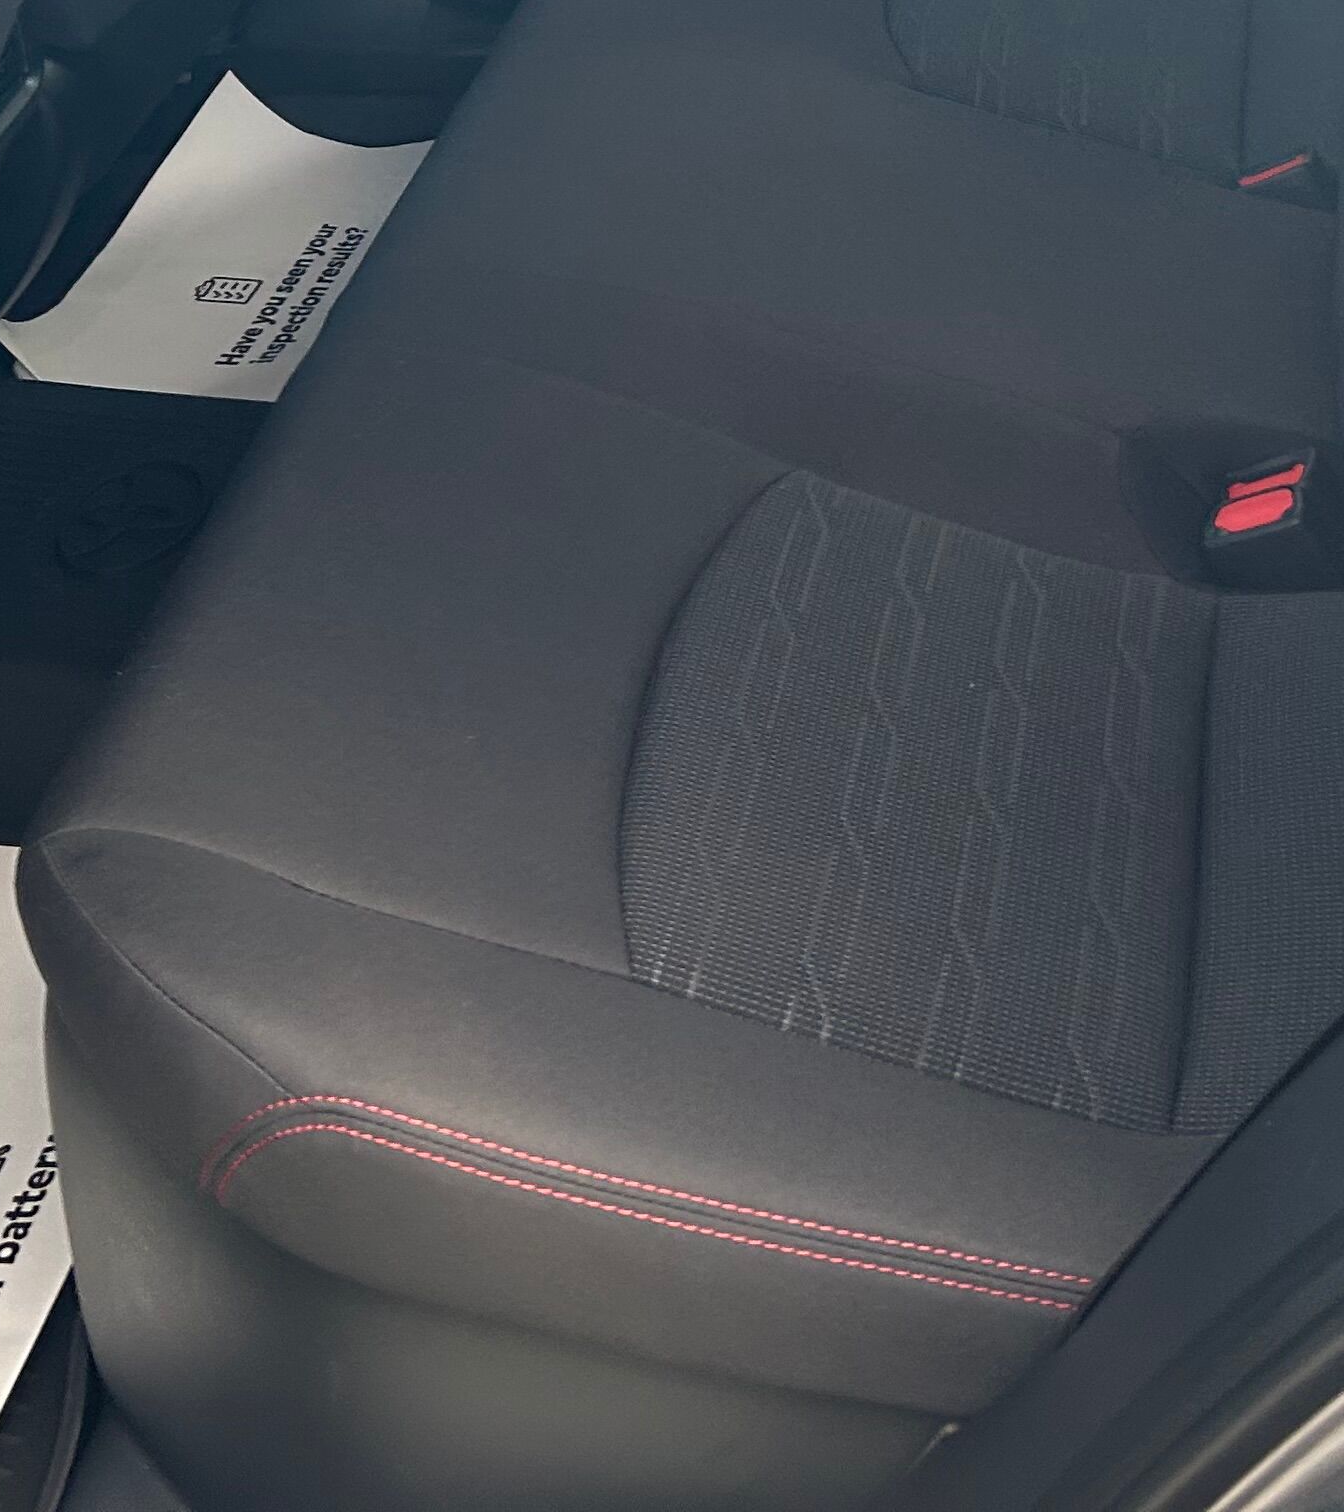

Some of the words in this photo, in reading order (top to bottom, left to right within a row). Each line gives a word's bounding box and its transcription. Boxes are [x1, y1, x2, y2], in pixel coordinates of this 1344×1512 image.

[214, 325, 264, 365] Have
[251, 295, 287, 326] you
[276, 258, 314, 294] seen
[302, 223, 339, 257] your
[249, 286, 330, 364] inspection
[316, 227, 370, 284] results?
